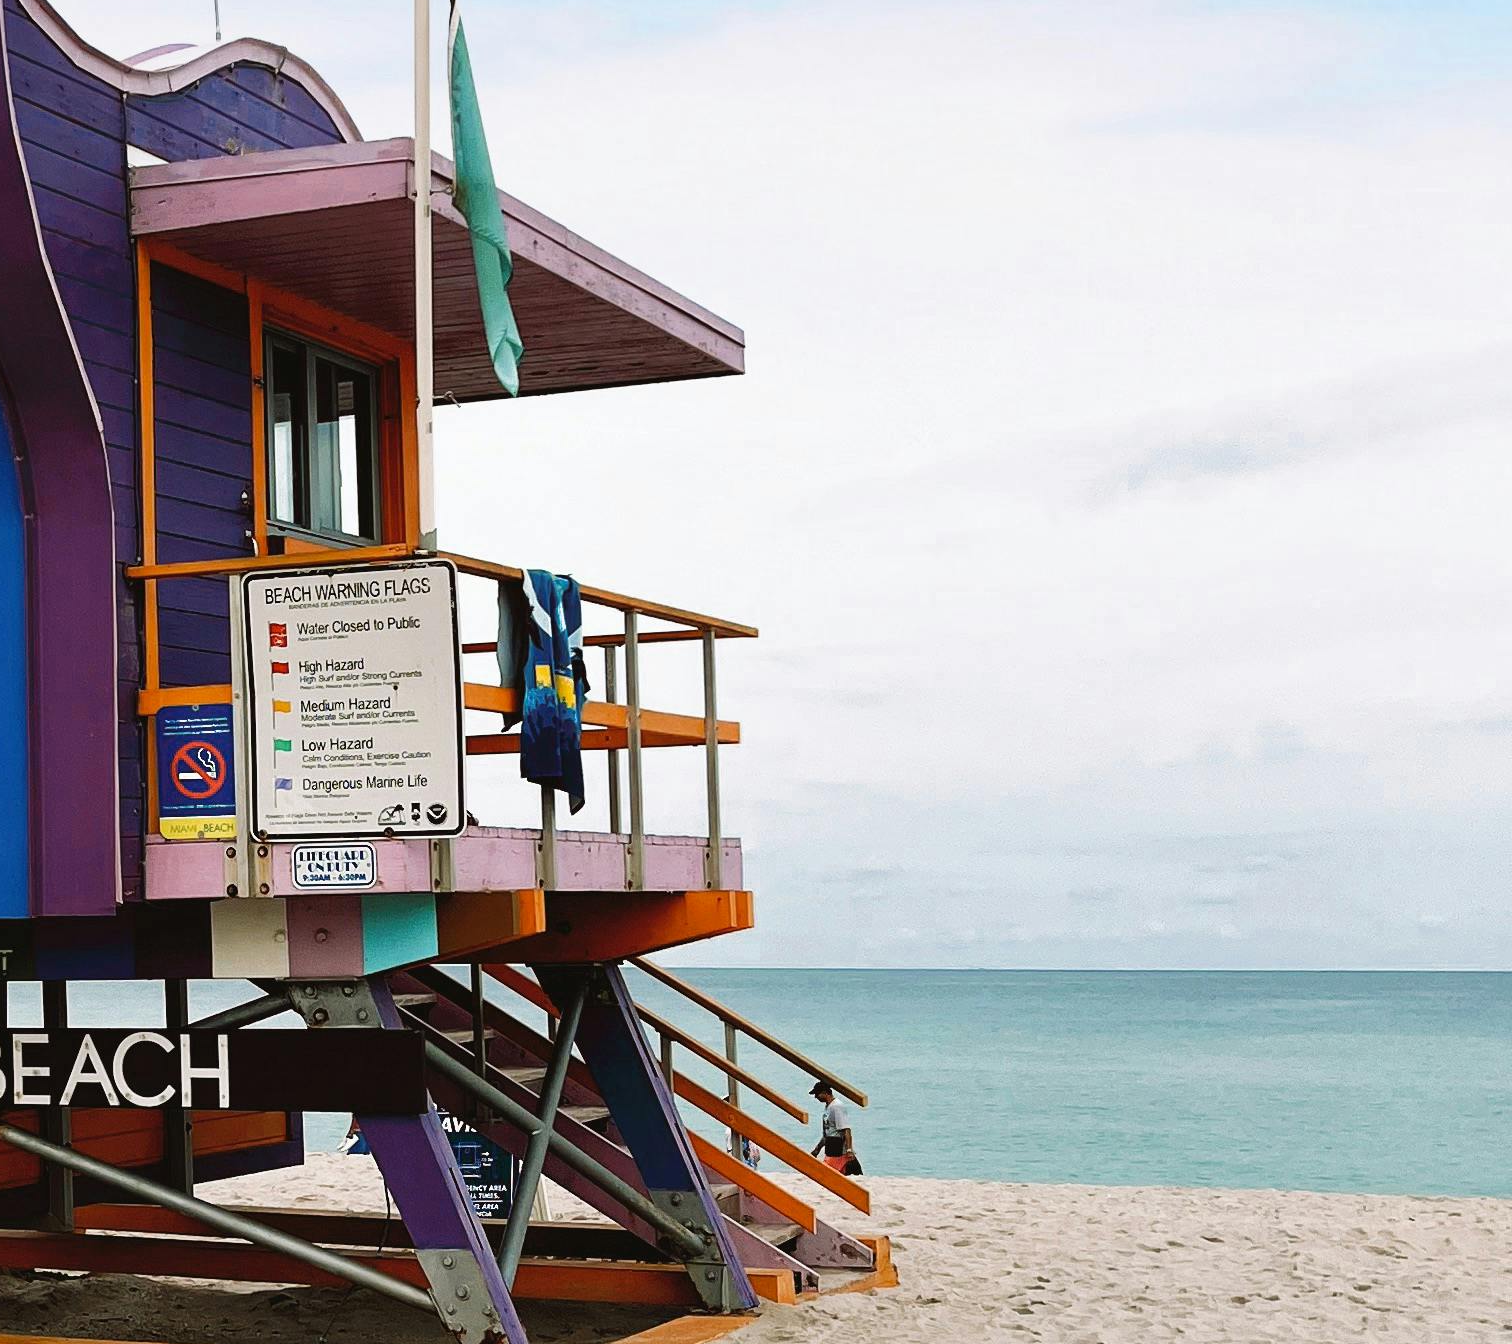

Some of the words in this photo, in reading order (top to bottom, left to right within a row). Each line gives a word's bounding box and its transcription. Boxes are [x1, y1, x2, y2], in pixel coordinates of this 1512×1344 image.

[265, 586, 311, 604] BEACH
[315, 581, 380, 600] WARNING
[384, 577, 431, 596] FLAGS
[297, 621, 329, 635] Water
[332, 619, 370, 633] Closed
[374, 619, 384, 630] to
[388, 616, 420, 629] Public
[299, 660, 323, 675] High
[326, 657, 364, 672] Hazard
[300, 675, 316, 684] High
[319, 673, 334, 682] Surf
[336, 673, 359, 681] and/or
[362, 672, 387, 681] Strong
[389, 670, 422, 679] Currents
[301, 699, 345, 713] Medium
[349, 697, 390, 710] Hazard
[301, 713, 336, 722] Moderate
[339, 712, 354, 720] Surf
[356, 711, 380, 719] and/or
[382, 709, 415, 718] Currents
[301, 739, 326, 752] Low
[330, 737, 373, 750] Hazard
[302, 754, 321, 762] Calm
[367, 752, 399, 760] Exercise
[401, 750, 431, 759] Caution
[303, 778, 363, 793] Dangerous
[366, 776, 403, 789] Marine
[408, 774, 427, 787] Life
[203, 823, 233, 832] BEACH
[299, 850, 369, 862] LIFEGUARD
[307, 862, 324, 872] ON
[327, 861, 360, 872] DUTY
